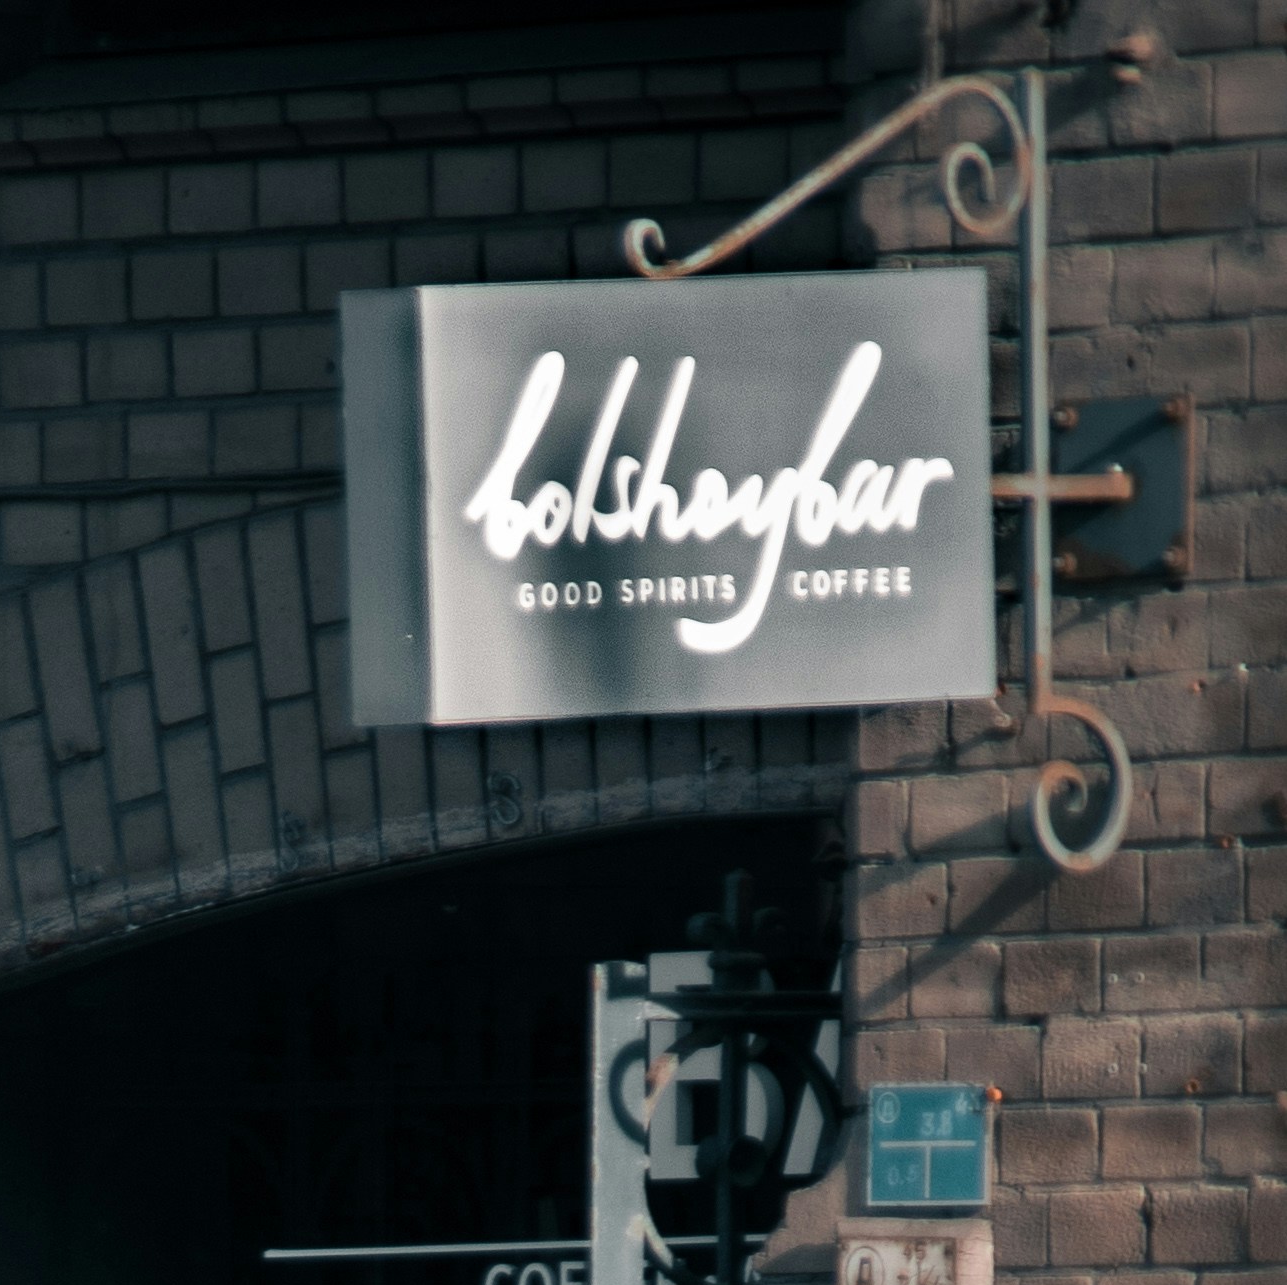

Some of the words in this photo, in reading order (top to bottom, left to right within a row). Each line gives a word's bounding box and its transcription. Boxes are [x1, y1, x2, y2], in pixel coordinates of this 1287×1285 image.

[519, 579, 603, 609] GOOD
[621, 573, 737, 604] SPIRITS
[791, 566, 913, 598] COFFEE
